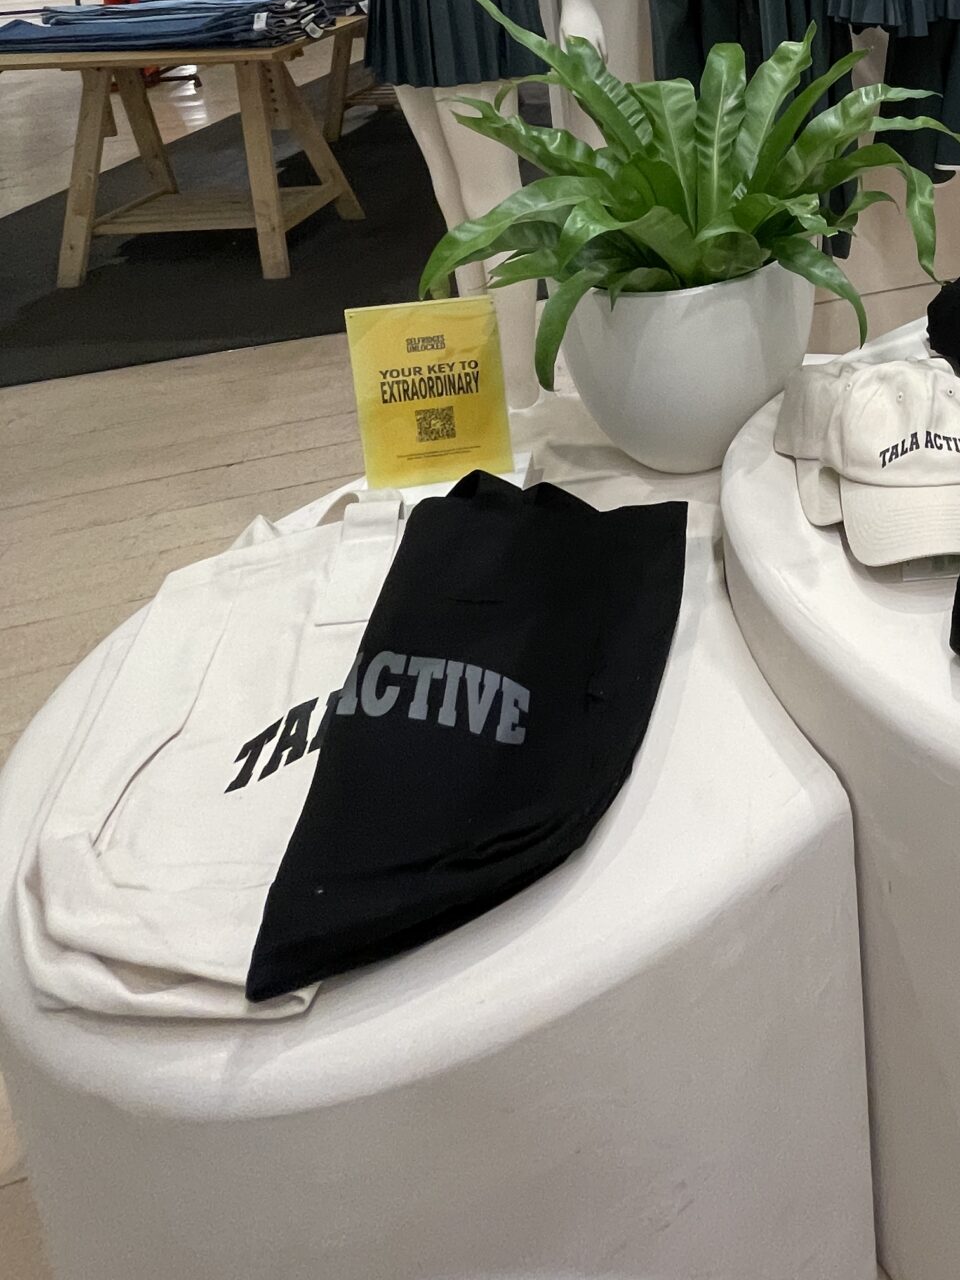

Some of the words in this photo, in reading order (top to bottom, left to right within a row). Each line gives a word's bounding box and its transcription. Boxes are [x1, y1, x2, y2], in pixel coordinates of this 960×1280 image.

[379, 366, 423, 380] YOUR
[428, 362, 457, 376] KEY
[459, 359, 479, 371] TO
[380, 371, 480, 404] EXTRAORDINARY
[879, 431, 920, 468] TALA
